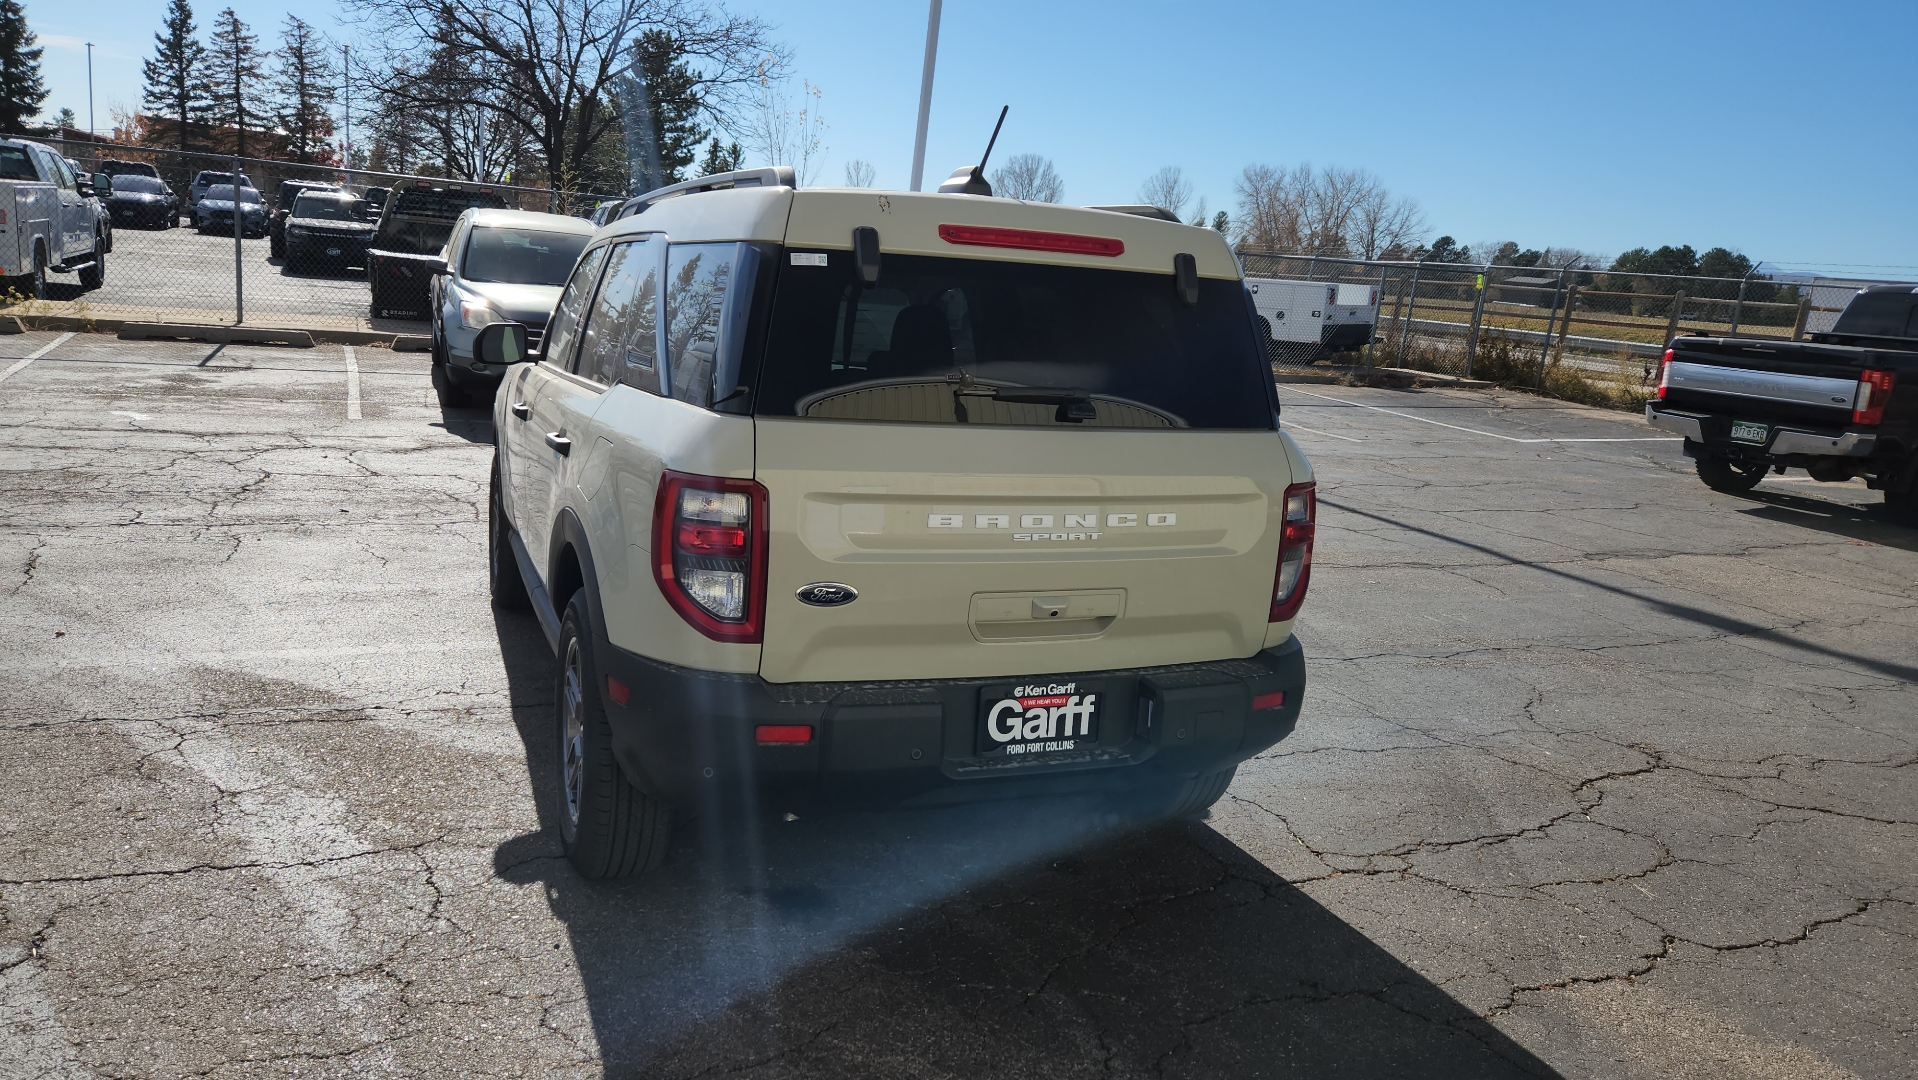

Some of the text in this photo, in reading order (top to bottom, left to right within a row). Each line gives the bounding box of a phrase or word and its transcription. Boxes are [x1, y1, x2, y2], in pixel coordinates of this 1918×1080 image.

[927, 512, 1177, 529] BRONCO
[1012, 531, 1104, 541] SPORT
[810, 587, 845, 602] Ford
[1024, 682, 1076, 696] Ken Garff
[987, 694, 1095, 742] Garff
[1007, 740, 1074, 754] FORD FORT COLLINS
